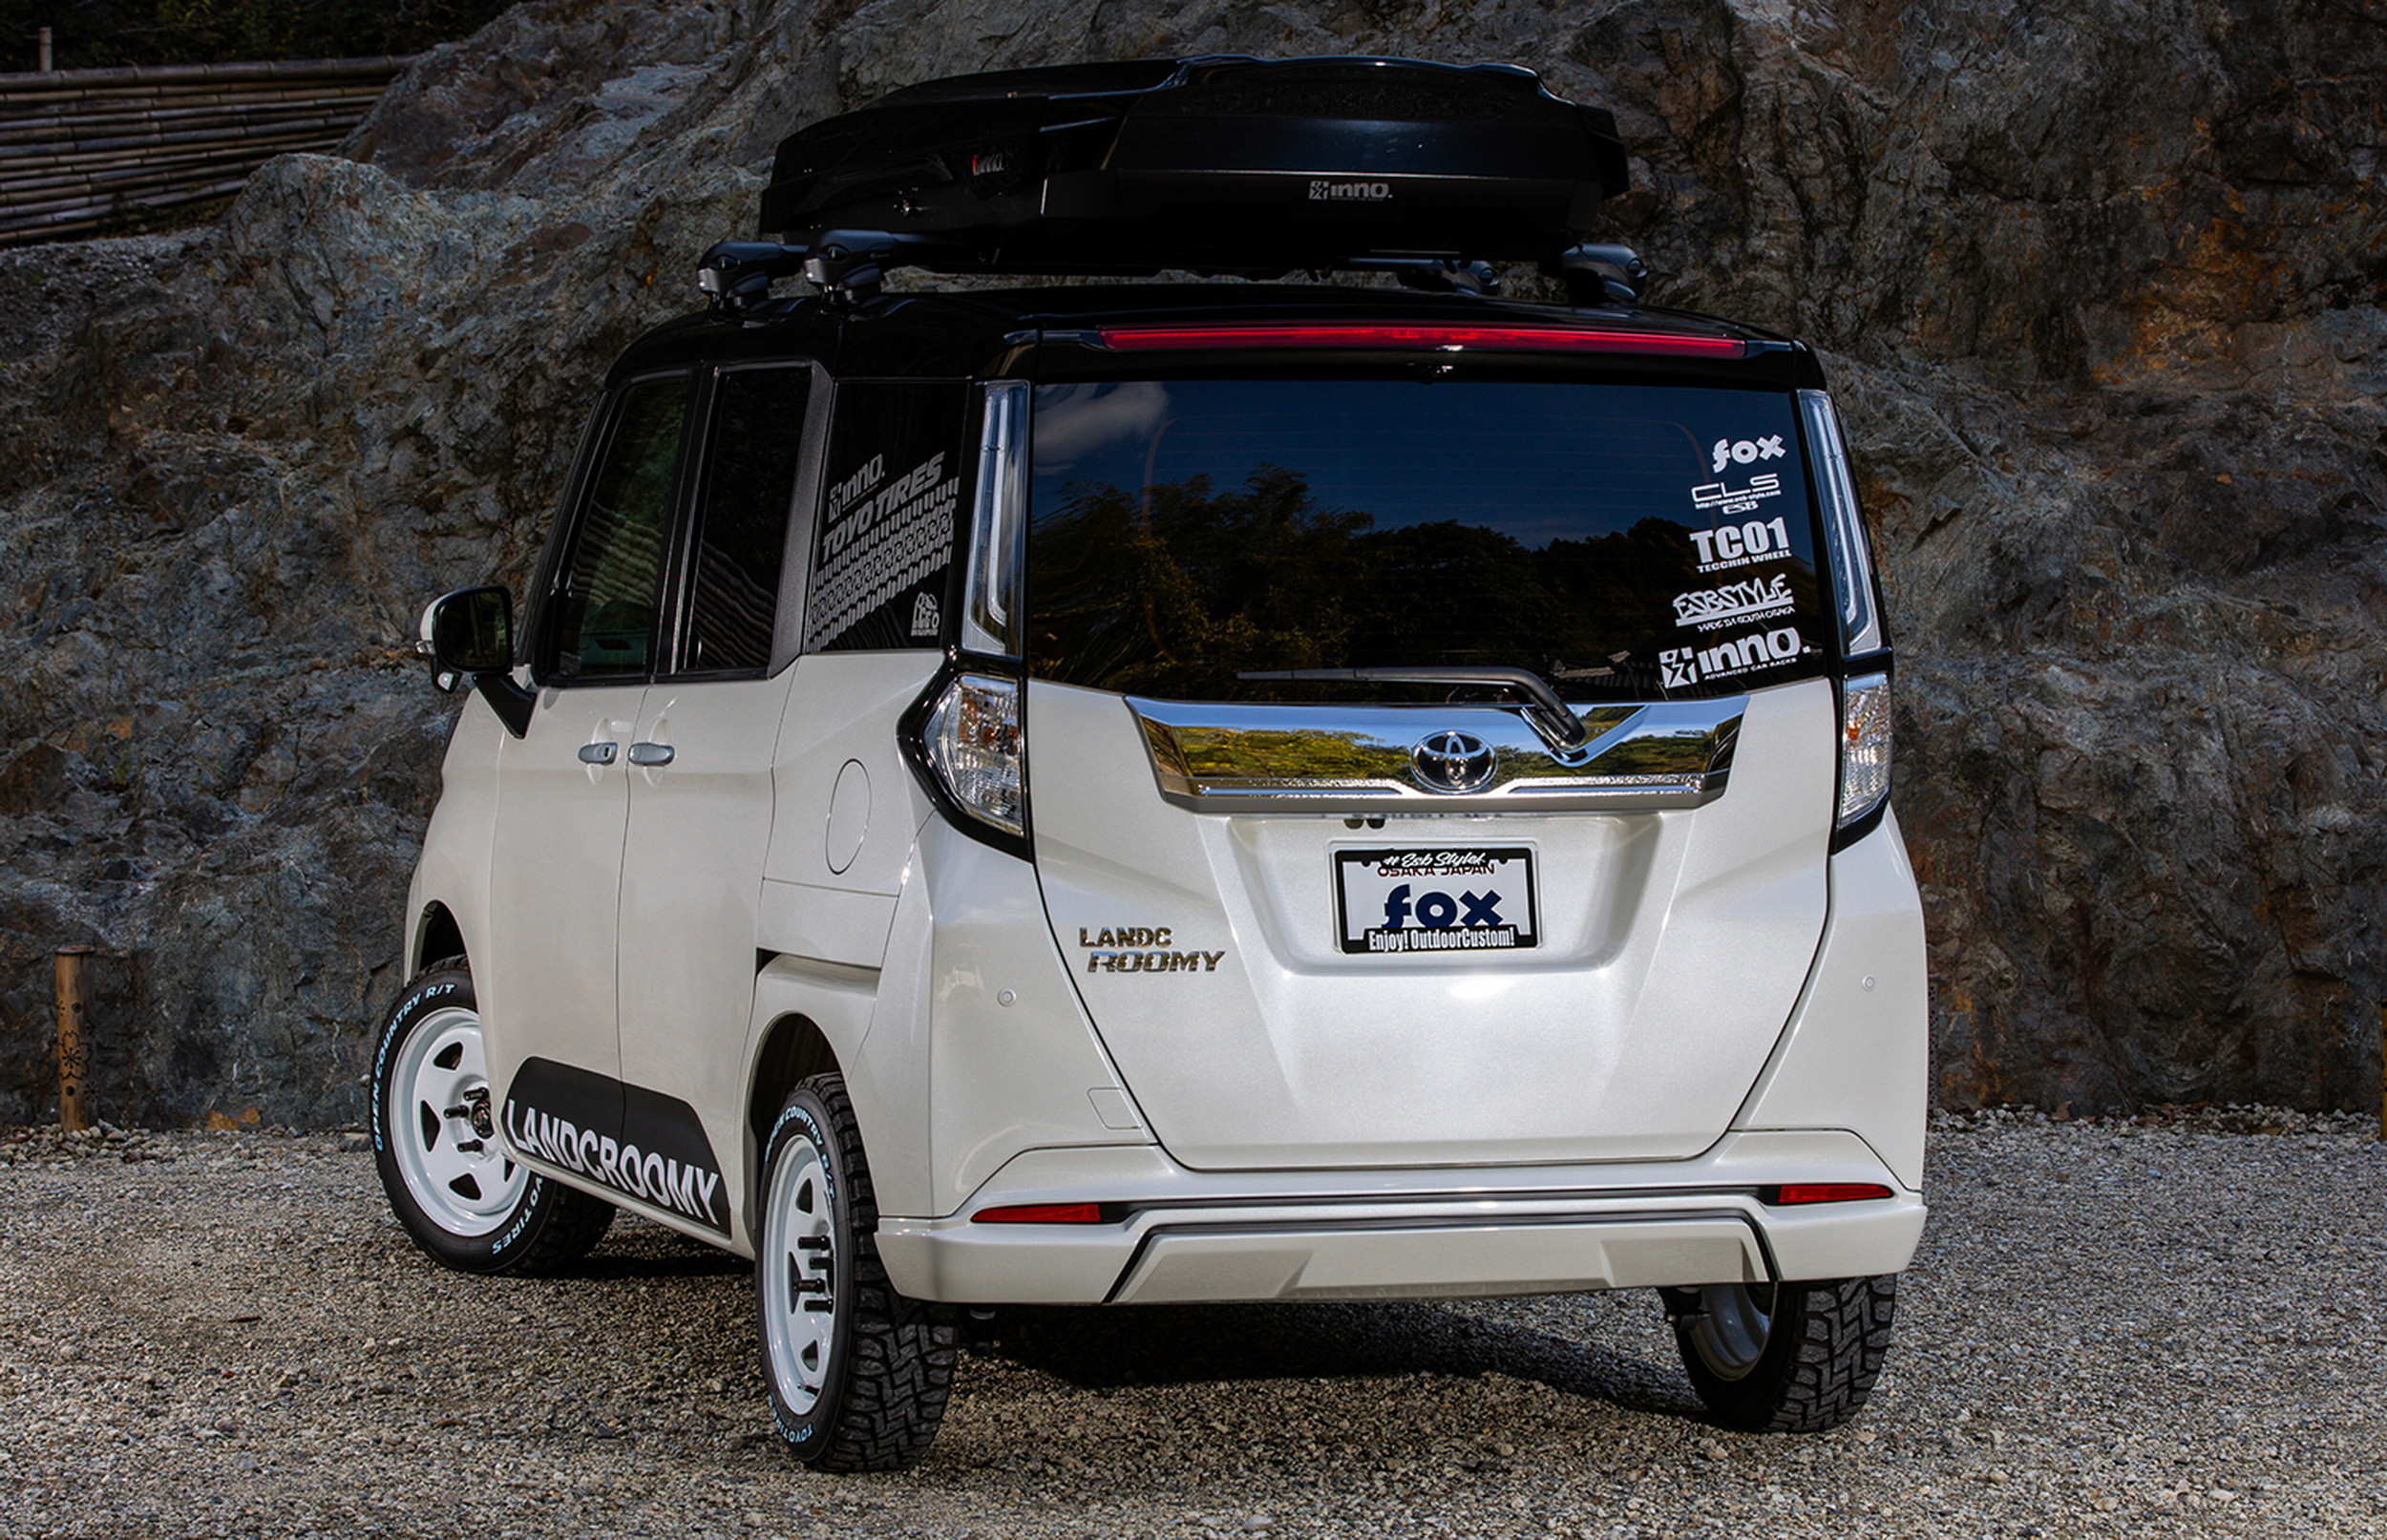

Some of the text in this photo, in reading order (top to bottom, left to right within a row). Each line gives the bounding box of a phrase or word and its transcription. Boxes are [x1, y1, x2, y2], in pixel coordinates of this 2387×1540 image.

[1712, 434, 1786, 473] fox
[1691, 474, 1780, 502] CLS
[822, 499, 875, 563] TOYO
[876, 452, 945, 522] TIRES
[1697, 550, 1792, 573] TECCHIN WHEEL
[1750, 663, 1767, 672] CAR
[1377, 863, 1495, 877] OSAKA JAPAN
[1382, 883, 1504, 929] fox
[1079, 927, 1172, 948] LANDC
[1368, 927, 1408, 952] Enjoy!
[1087, 951, 1226, 973] ROOMY
[375, 993, 422, 1079] COUNTRY
[426, 983, 456, 999] R/T
[785, 1106, 824, 1146] COUNTRY
[507, 1099, 719, 1226] LANDCROOMY
[492, 1208, 533, 1255] TIRES
